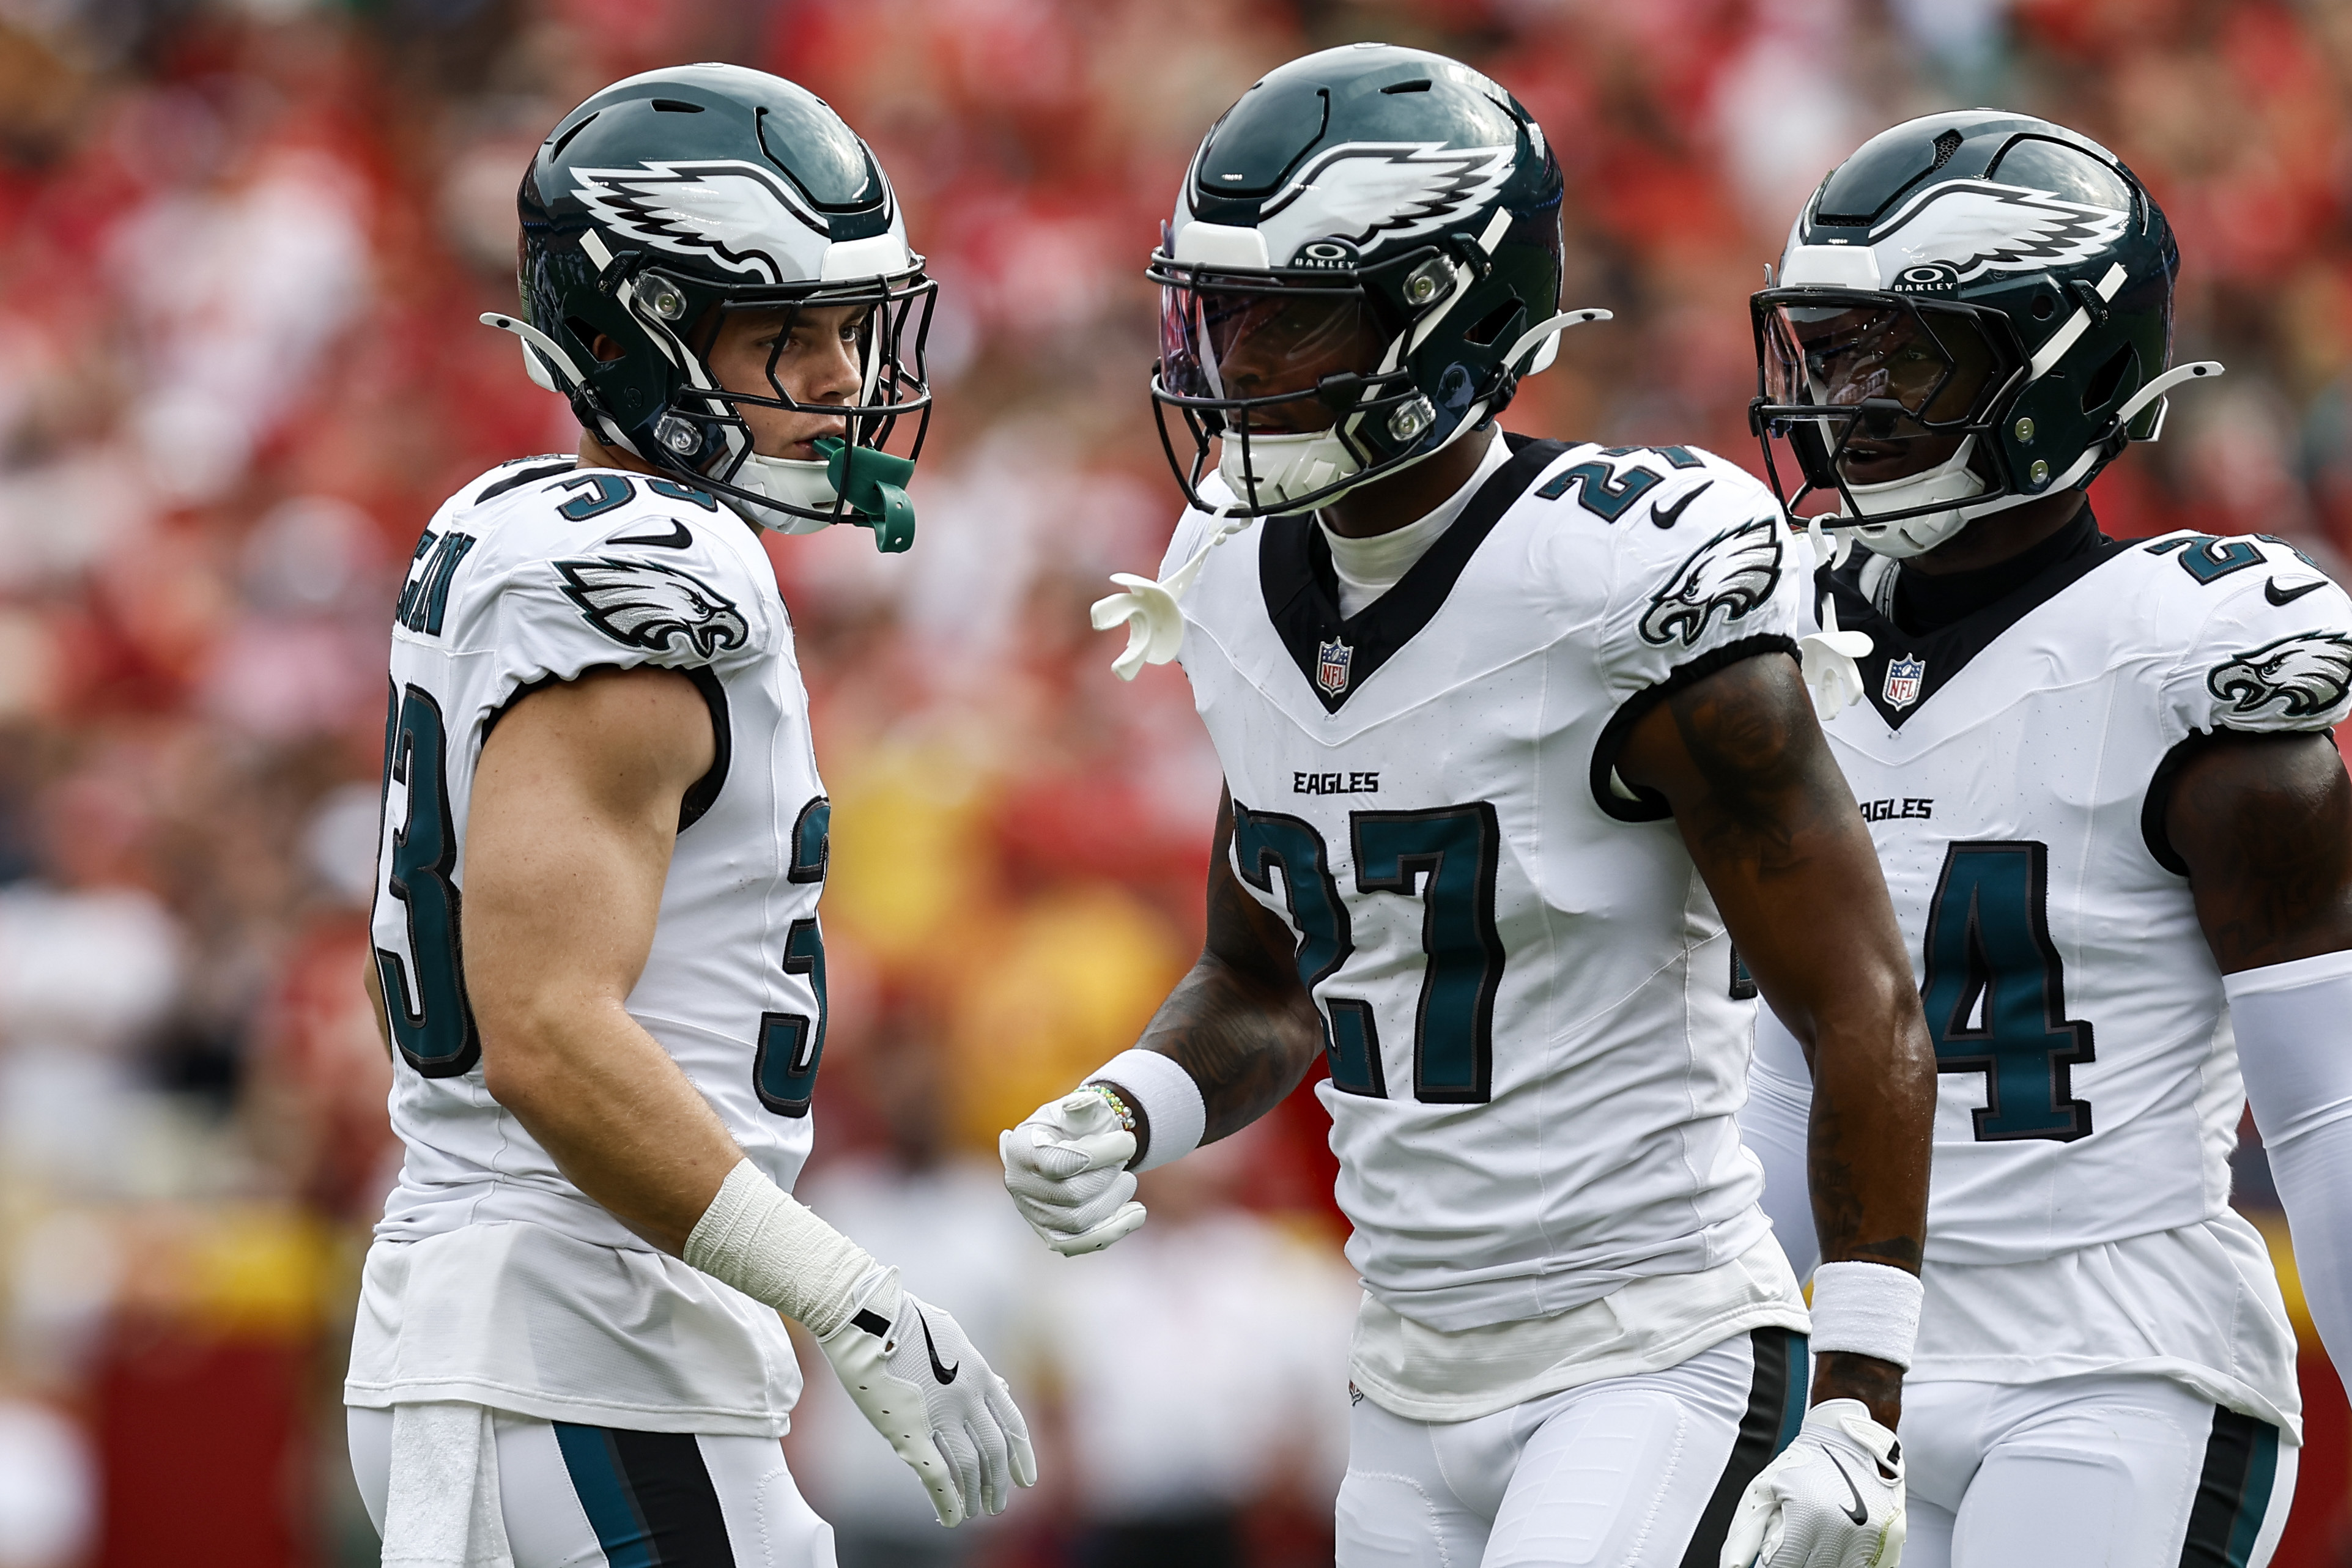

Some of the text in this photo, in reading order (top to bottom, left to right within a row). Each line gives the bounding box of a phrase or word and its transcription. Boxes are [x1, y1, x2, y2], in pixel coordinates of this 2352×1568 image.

[1295, 257, 1355, 269] OAKLEY
[1895, 283, 1954, 292] OAKLEY
[1322, 664, 1344, 687] NFL
[1888, 679, 1914, 701] NFL
[1293, 772, 1380, 795] EAGLES
[1860, 797, 1934, 823] AGLES
[369, 670, 483, 1079] 3
[1233, 797, 1506, 1104] 27
